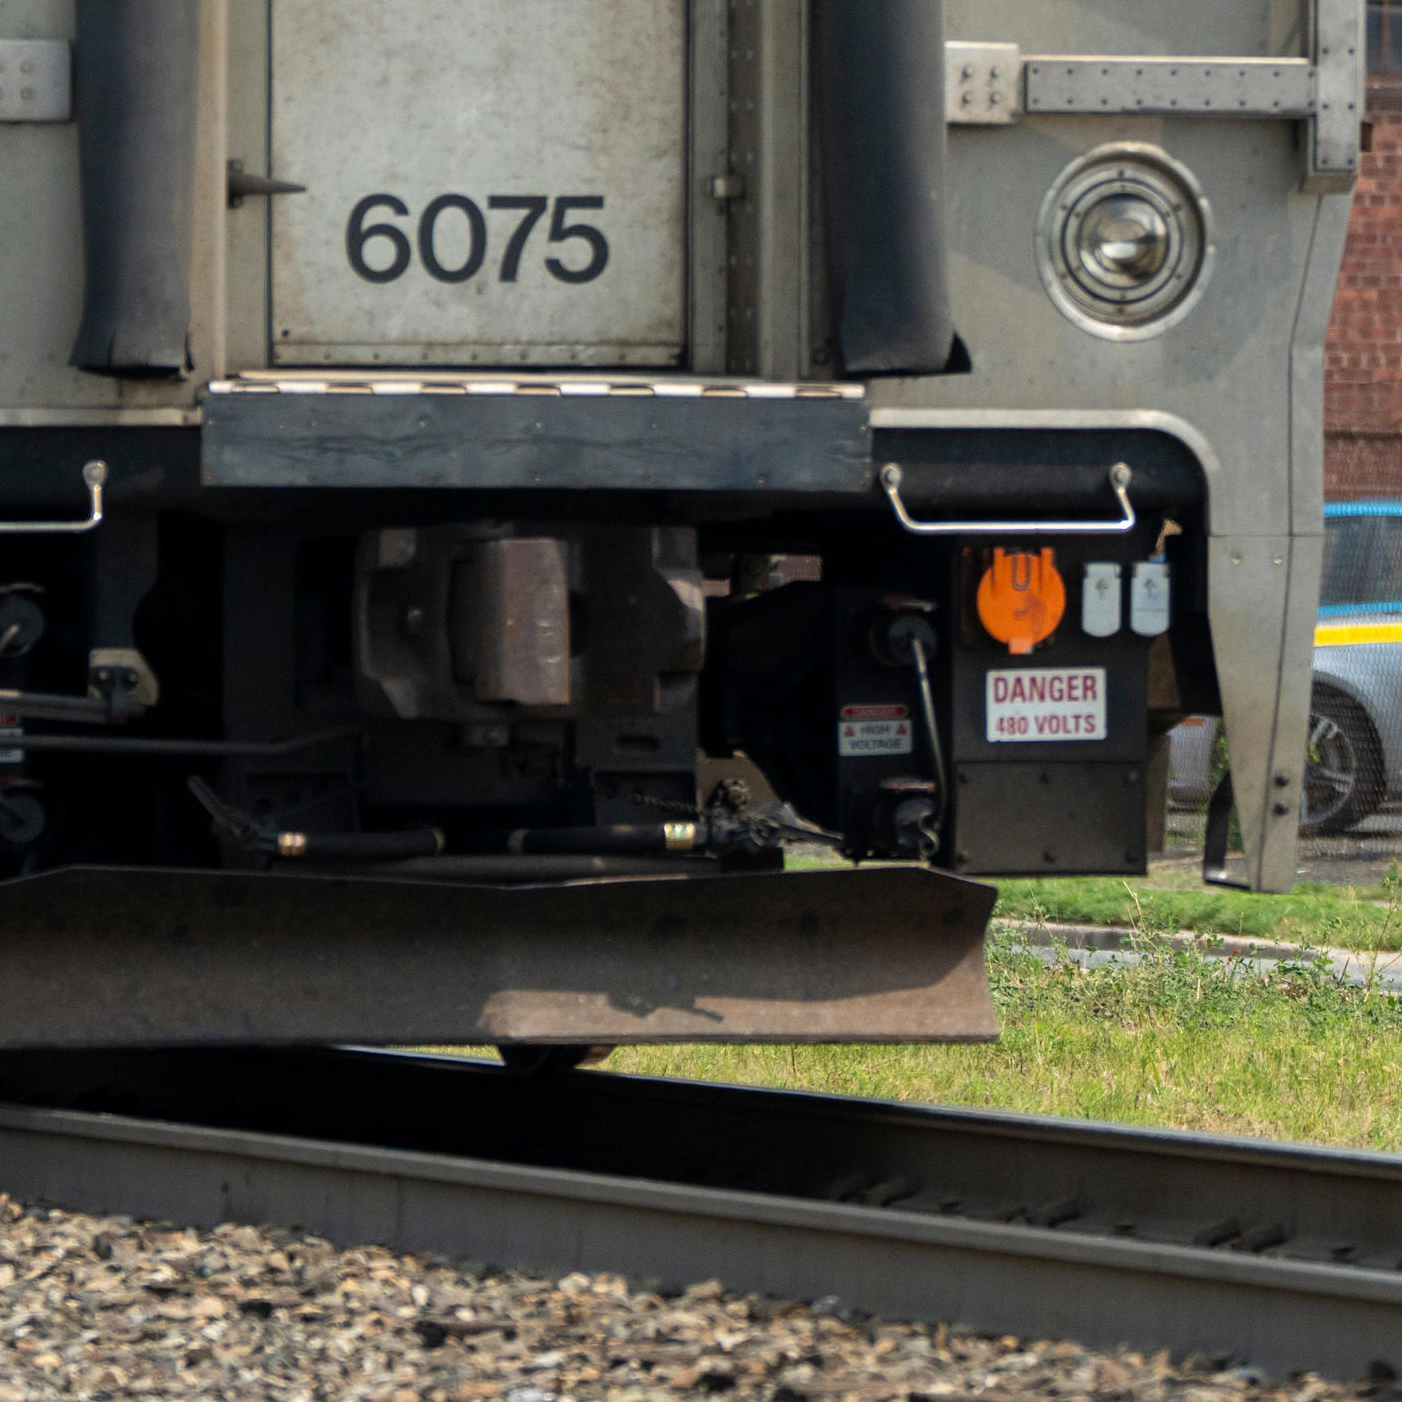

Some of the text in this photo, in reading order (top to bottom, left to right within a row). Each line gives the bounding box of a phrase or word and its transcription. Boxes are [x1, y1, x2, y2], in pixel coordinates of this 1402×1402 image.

[345, 193, 610, 284] 6075
[994, 675, 1098, 703] DANGER
[996, 715, 1096, 735] 480 VOLTS
[848, 738, 902, 751] VOLTAGE
